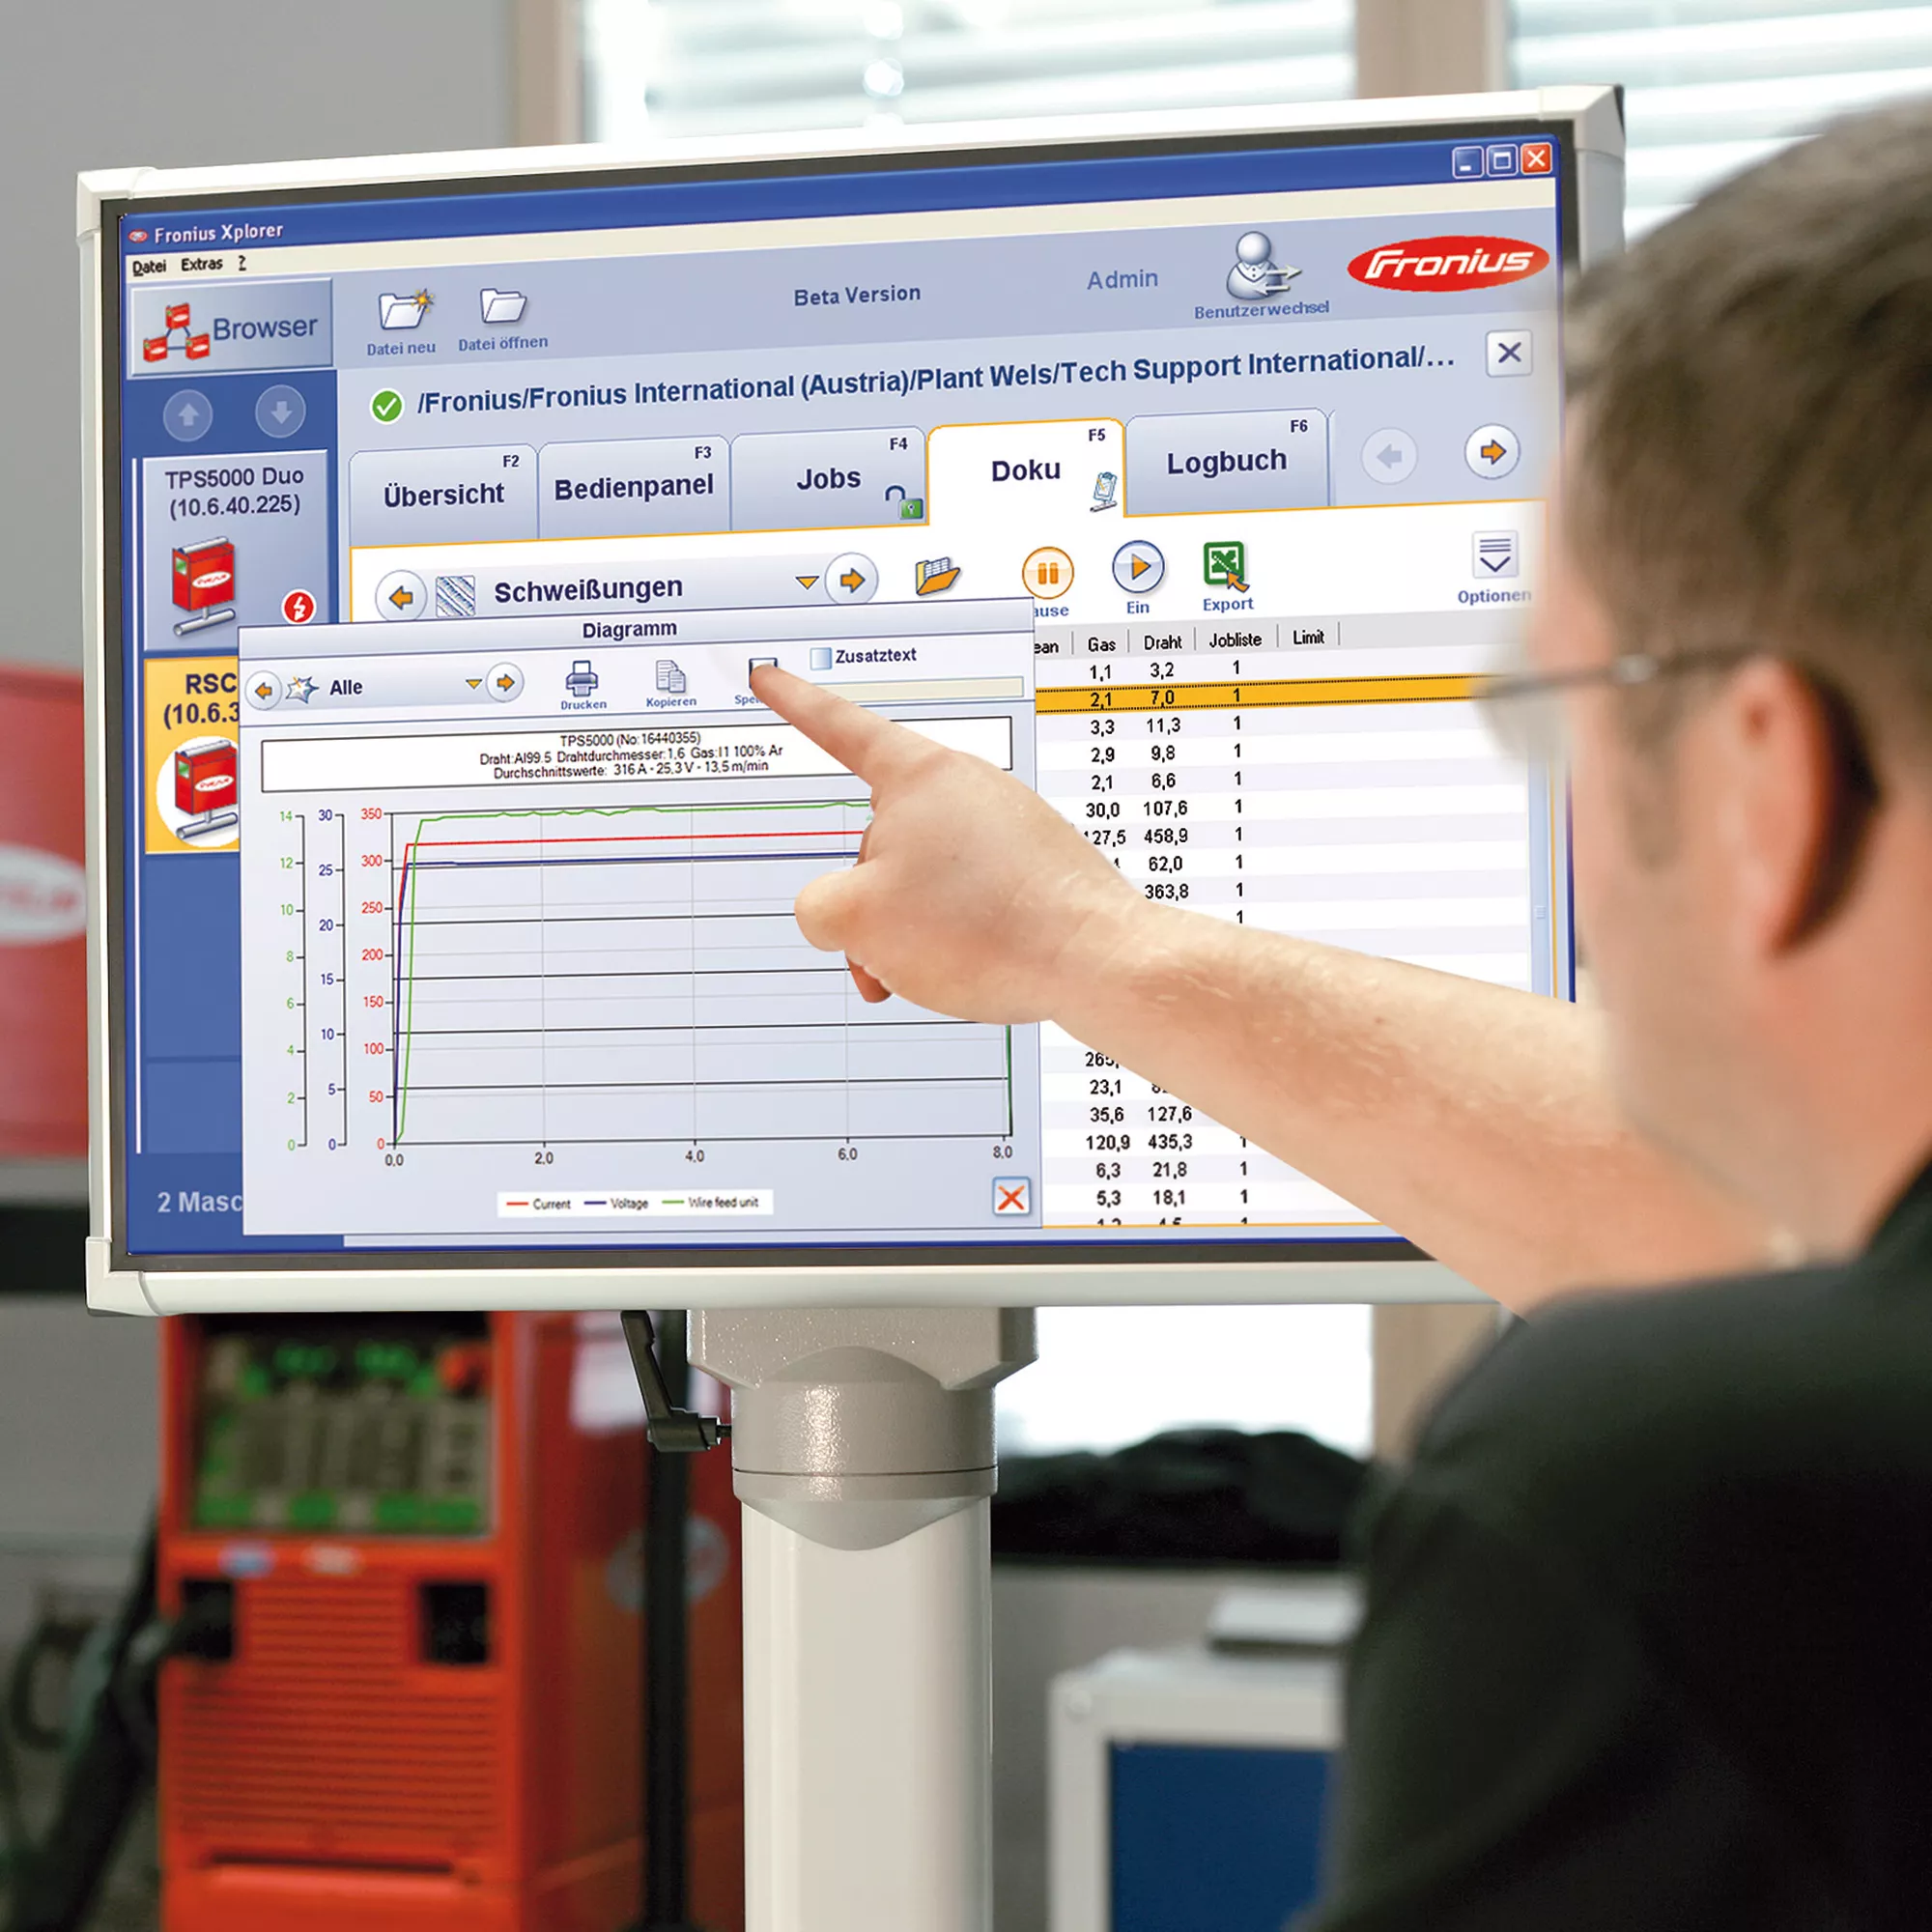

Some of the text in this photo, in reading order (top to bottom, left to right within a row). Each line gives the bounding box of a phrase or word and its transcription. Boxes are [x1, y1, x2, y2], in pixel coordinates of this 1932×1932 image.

[155, 226, 216, 243] Fronius
[221, 223, 283, 243] Xplorer
[132, 255, 246, 276] Datei Extras ?
[1365, 247, 1535, 280] Fronius
[1087, 269, 1159, 291] Admin
[794, 285, 921, 306] Beta Version
[1194, 299, 1330, 320] Benutzerwechsel
[213, 318, 318, 340] Browser
[367, 341, 436, 356] Datei neu
[459, 334, 549, 353] Datei öffnen
[417, 382, 626, 414] /Fronius/Fronius
[634, 375, 795, 405] International
[802, 364, 983, 401] (Austria)/Plant
[990, 358, 1127, 388] Wels/Tech
[1134, 354, 1242, 384] Support
[1291, 420, 1308, 433] F6
[1089, 429, 1106, 441] F5
[890, 438, 908, 451] F4
[695, 446, 712, 460] F3
[502, 455, 520, 469] F2
[1167, 449, 1288, 478] Logbuch
[992, 459, 1062, 484] Doku
[165, 468, 305, 491] TPS5000 Duo
[797, 468, 863, 492] Jobs
[384, 482, 505, 509] Übersicht
[554, 473, 714, 503] Bedienpanel
[170, 495, 300, 520] (10.6.40.225)
[495, 574, 683, 605] Schweißungen
[1458, 588, 1532, 606] Optionen
[1126, 601, 1150, 614] Ein
[1203, 597, 1254, 612] Export
[582, 621, 678, 640] Diagramm
[1088, 637, 1117, 653] Gas
[1144, 634, 1182, 651] Draht
[1209, 632, 1263, 649] Jobliste
[1293, 630, 1325, 645] Limit
[836, 647, 917, 665] Zusatztext
[1090, 659, 1239, 681] 1,1 3,2 1
[185, 672, 237, 695] RSC
[329, 680, 363, 696] Alle
[560, 700, 607, 711] Drucken
[646, 697, 696, 709] Kopieren
[1091, 688, 1240, 710] 2,1 7,0 1
[1091, 716, 1241, 737] 3,3 11,3 1
[560, 734, 613, 747] TPS5000
[734, 745, 765, 757] 100%
[769, 744, 783, 756] Ar
[1091, 744, 1241, 764] 2,9 9,8 1
[494, 765, 608, 780] Durchschnittswerte:
[613, 763, 636, 776] 316
[637, 763, 647, 775] A
[684, 761, 695, 773] V
[732, 759, 769, 774] m/min
[1092, 772, 1241, 791] 2,1 6,6 1
[279, 810, 293, 822] 14
[318, 810, 333, 821] 30
[361, 809, 383, 820] 350
[1086, 799, 1242, 818] 30,0 107,6 1
[1144, 828, 1188, 845] 458,9
[1236, 827, 1242, 841] 1
[280, 858, 293, 868] 12
[361, 855, 384, 867] 300
[1149, 855, 1243, 873] 62,0 1
[318, 865, 333, 876] 25
[1145, 882, 1243, 901] 363,8 1
[280, 905, 293, 916] 10
[361, 902, 384, 914] 250
[1236, 910, 1243, 923] 1
[319, 920, 334, 931] 20
[286, 951, 294, 962] 8
[361, 950, 384, 961] 200
[321, 975, 334, 986] 15
[286, 998, 294, 1009] 6
[363, 996, 384, 1008] 150
[321, 1029, 334, 1040] 10
[286, 1044, 295, 1056] 4
[364, 1043, 384, 1055] 100
[328, 1084, 336, 1095] 5
[1090, 1079, 1122, 1096] 23,1
[287, 1094, 295, 1104] 2
[369, 1091, 384, 1102] 50
[1091, 1106, 1192, 1123] 35,6 127,6
[288, 1140, 296, 1151] 0
[328, 1139, 336, 1151] 0
[377, 1138, 384, 1150] 0
[1086, 1134, 1130, 1151] 120,9
[1149, 1133, 1192, 1151] 435,3
[1096, 1161, 1246, 1179] 6,3 21,8 1
[157, 1191, 242, 1212] 2 Masc
[533, 1198, 571, 1209] Current
[611, 1197, 648, 1210] Voltage
[689, 1196, 758, 1208] Wire feed unit
[1096, 1189, 1247, 1208] 5,3 18,1 1
